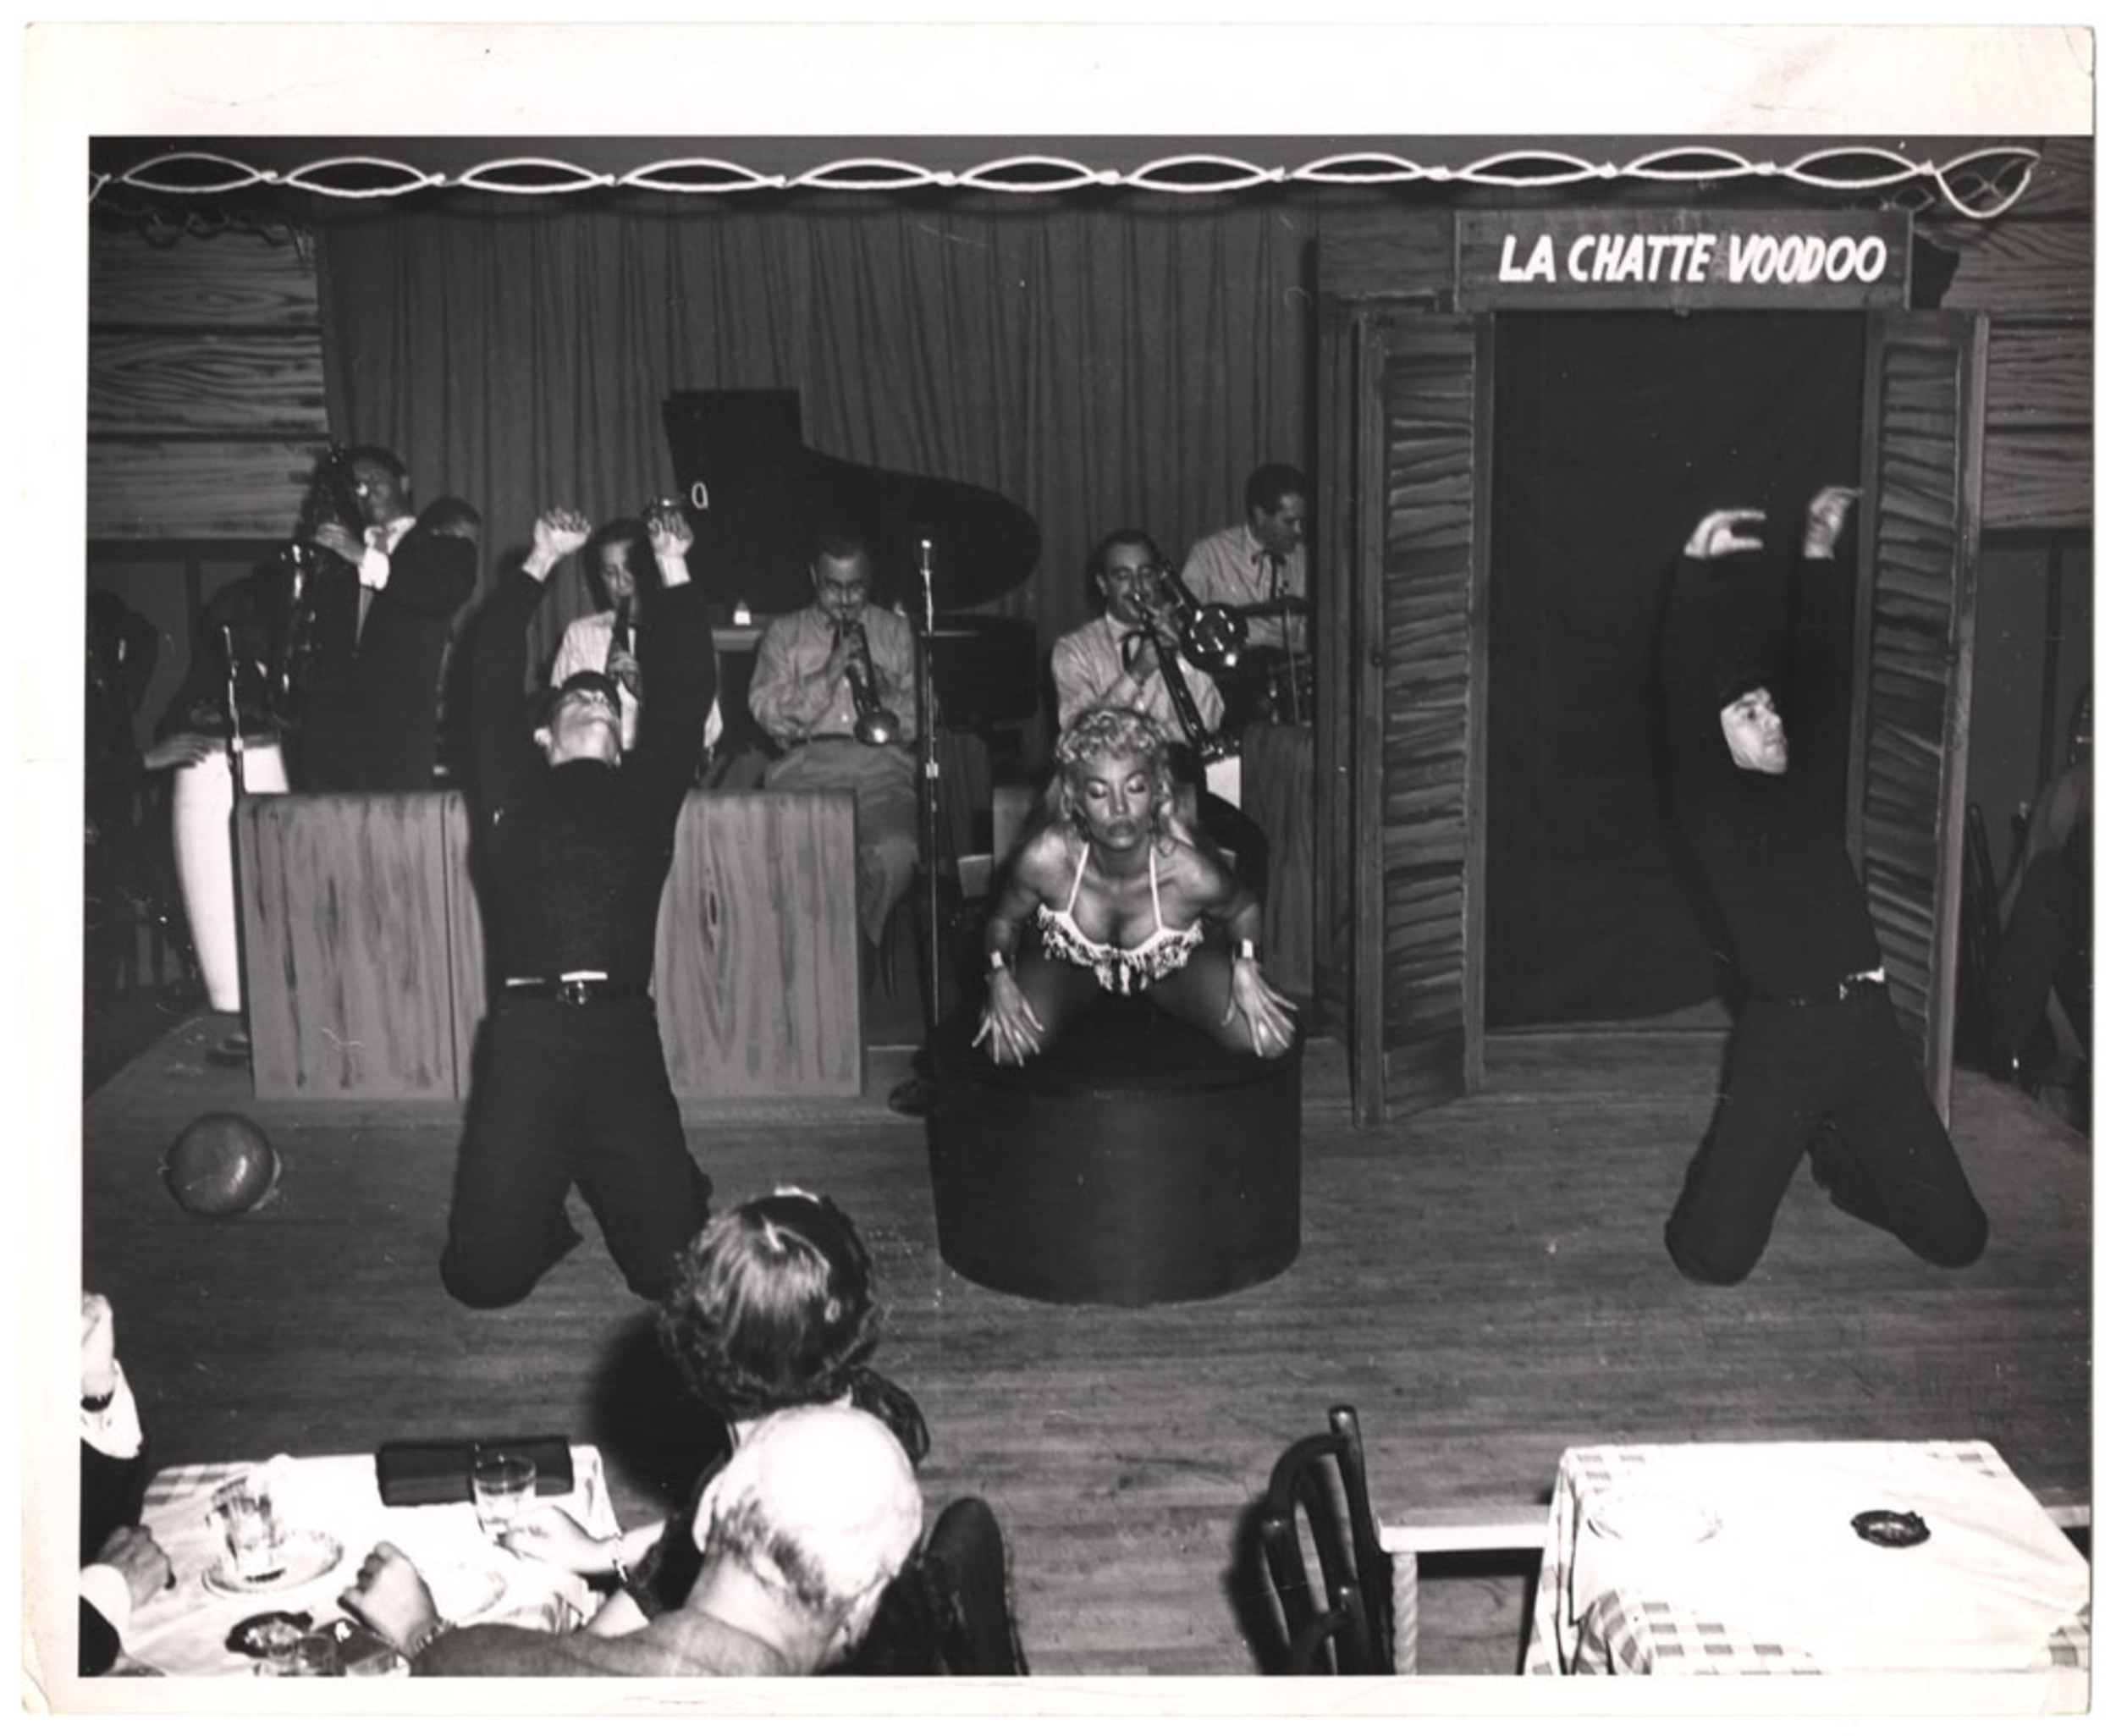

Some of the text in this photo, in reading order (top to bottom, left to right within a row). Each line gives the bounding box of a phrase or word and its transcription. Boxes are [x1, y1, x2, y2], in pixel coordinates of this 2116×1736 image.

[1498, 232, 1887, 284] LA CHATTE VOODOO
